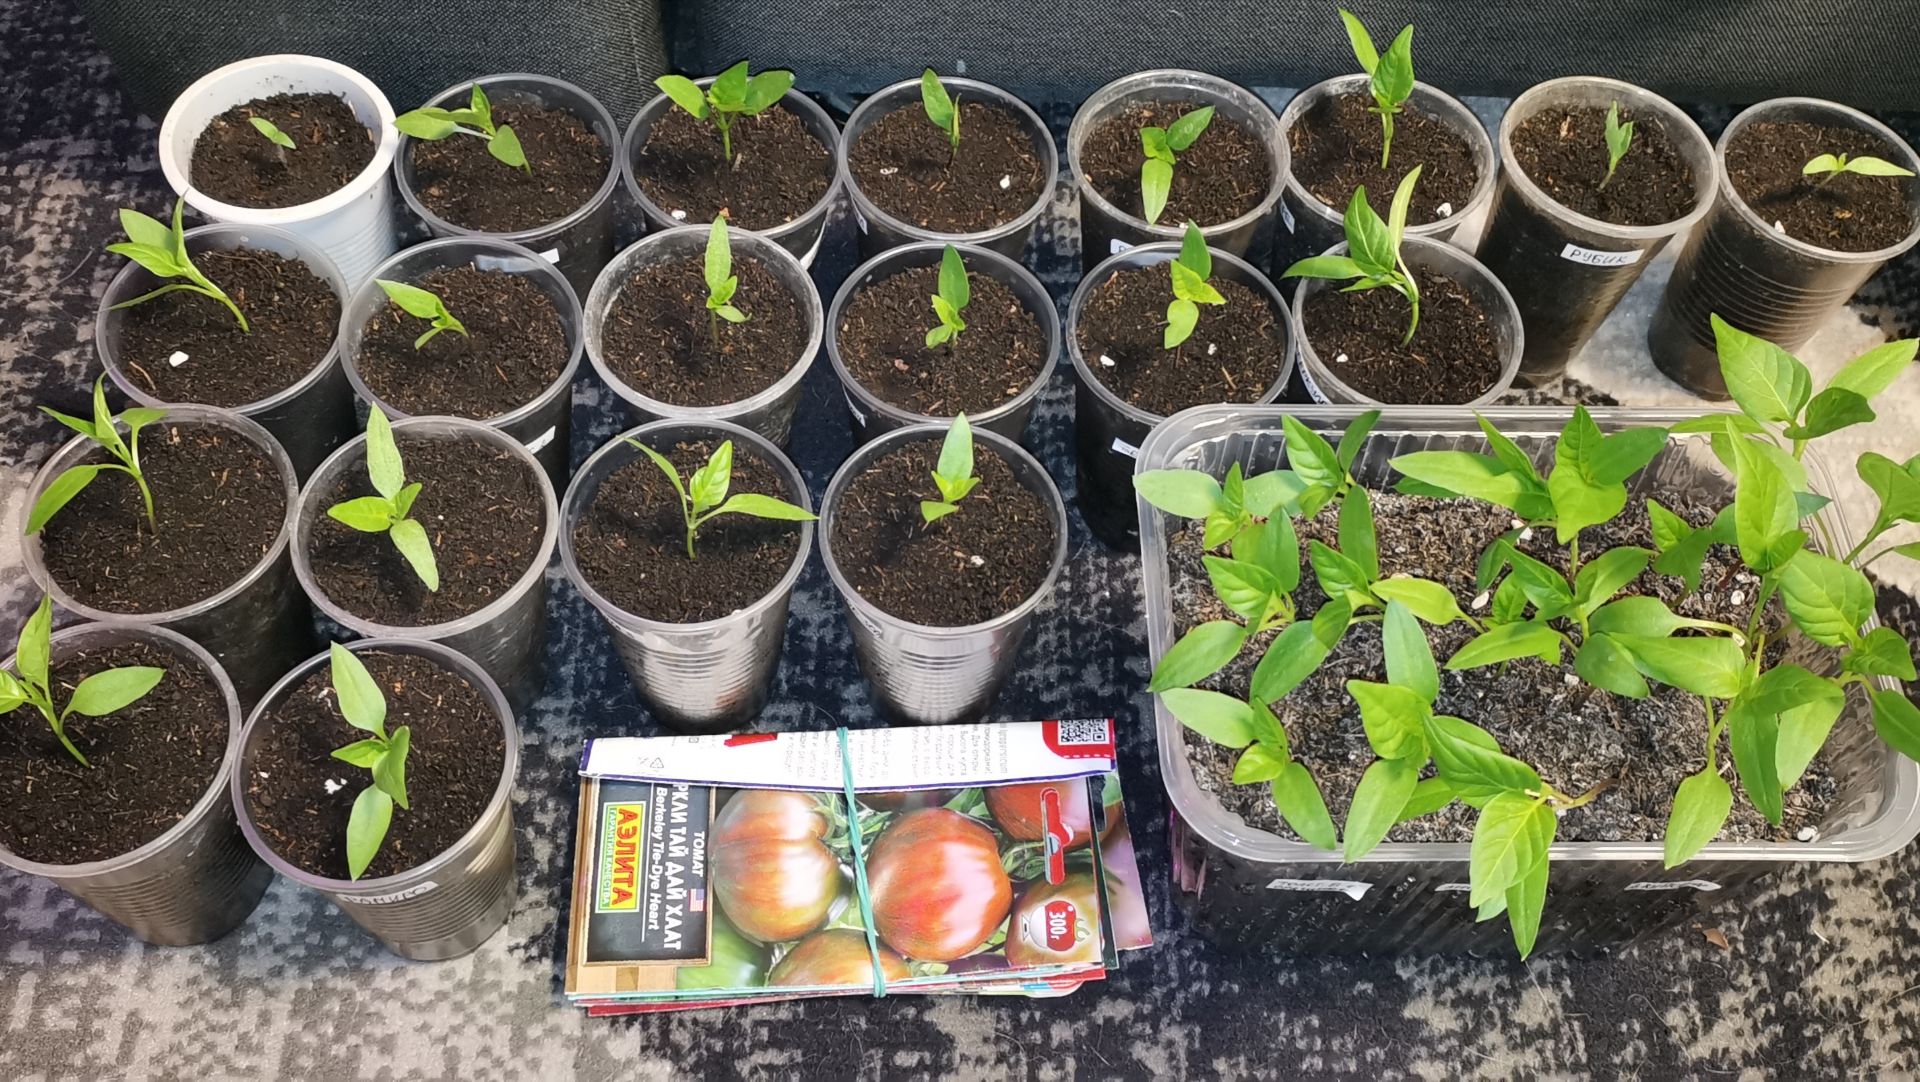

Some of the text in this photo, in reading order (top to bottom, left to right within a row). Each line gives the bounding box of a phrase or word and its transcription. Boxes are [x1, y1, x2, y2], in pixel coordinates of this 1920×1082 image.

[1570, 249, 1628, 264] РУБИК
[602, 809, 618, 905] ГАРАНТИЯ КАЧЕСТВА
[611, 808, 639, 905] АЭЛИТА
[648, 787, 668, 930] Berkeley Tie-Dye Heart
[669, 826, 689, 857] ТАЙ
[692, 831, 705, 877] ТОМАТ
[665, 861, 687, 900] ДАЙ
[663, 904, 684, 950] ХААТ
[1048, 911, 1068, 940] 300г
